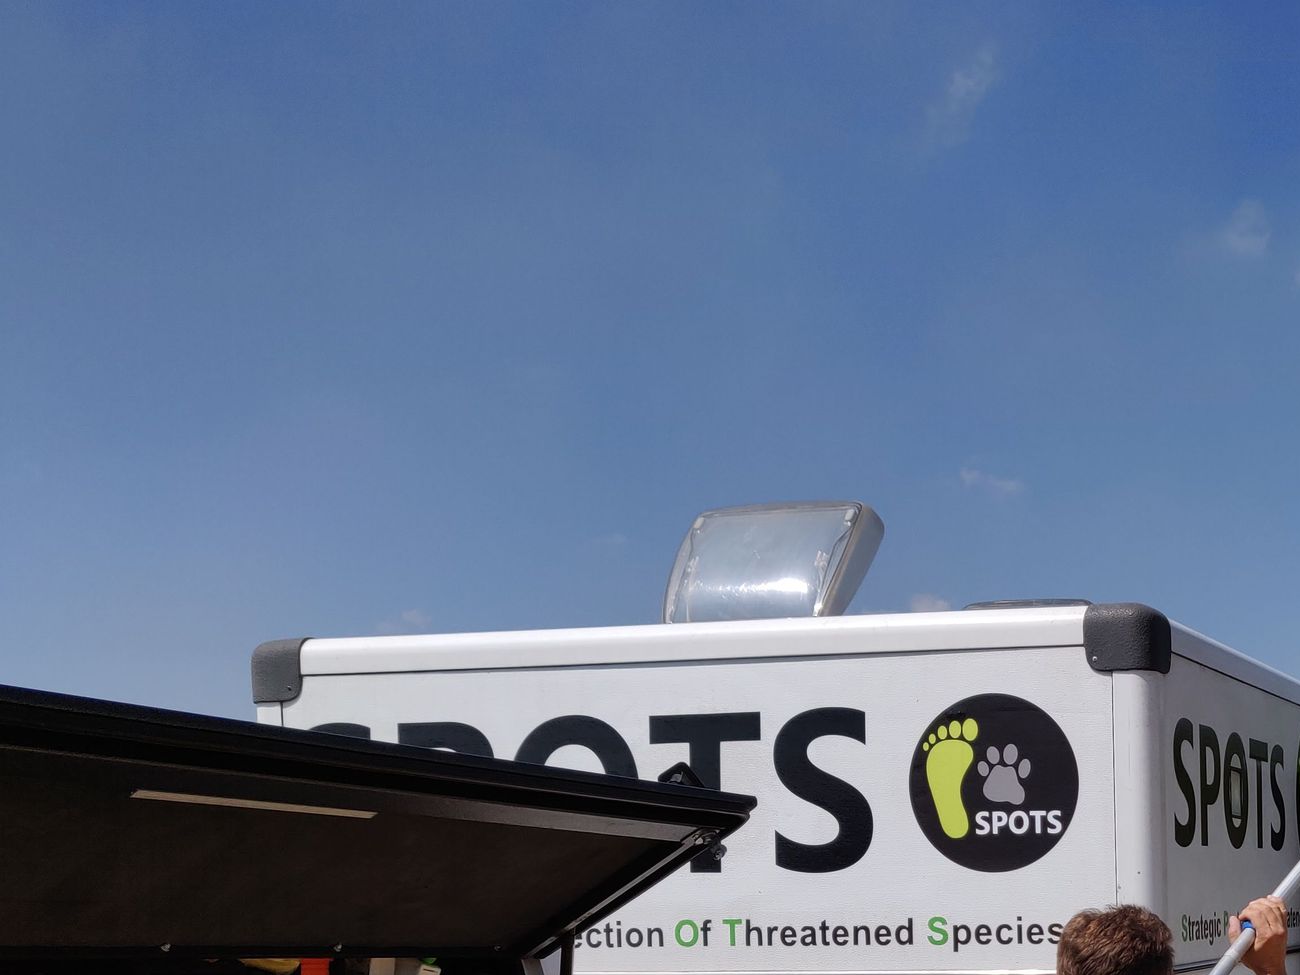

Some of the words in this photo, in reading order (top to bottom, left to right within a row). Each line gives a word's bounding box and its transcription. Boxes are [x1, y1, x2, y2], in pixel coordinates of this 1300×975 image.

[1173, 717, 1286, 851] SPOTS
[975, 810, 1063, 835] SPOTS
[674, 918, 713, 948] Of
[722, 917, 914, 948] Threatened
[926, 916, 1063, 952] Species
[1181, 912, 1222, 946] Strategic
